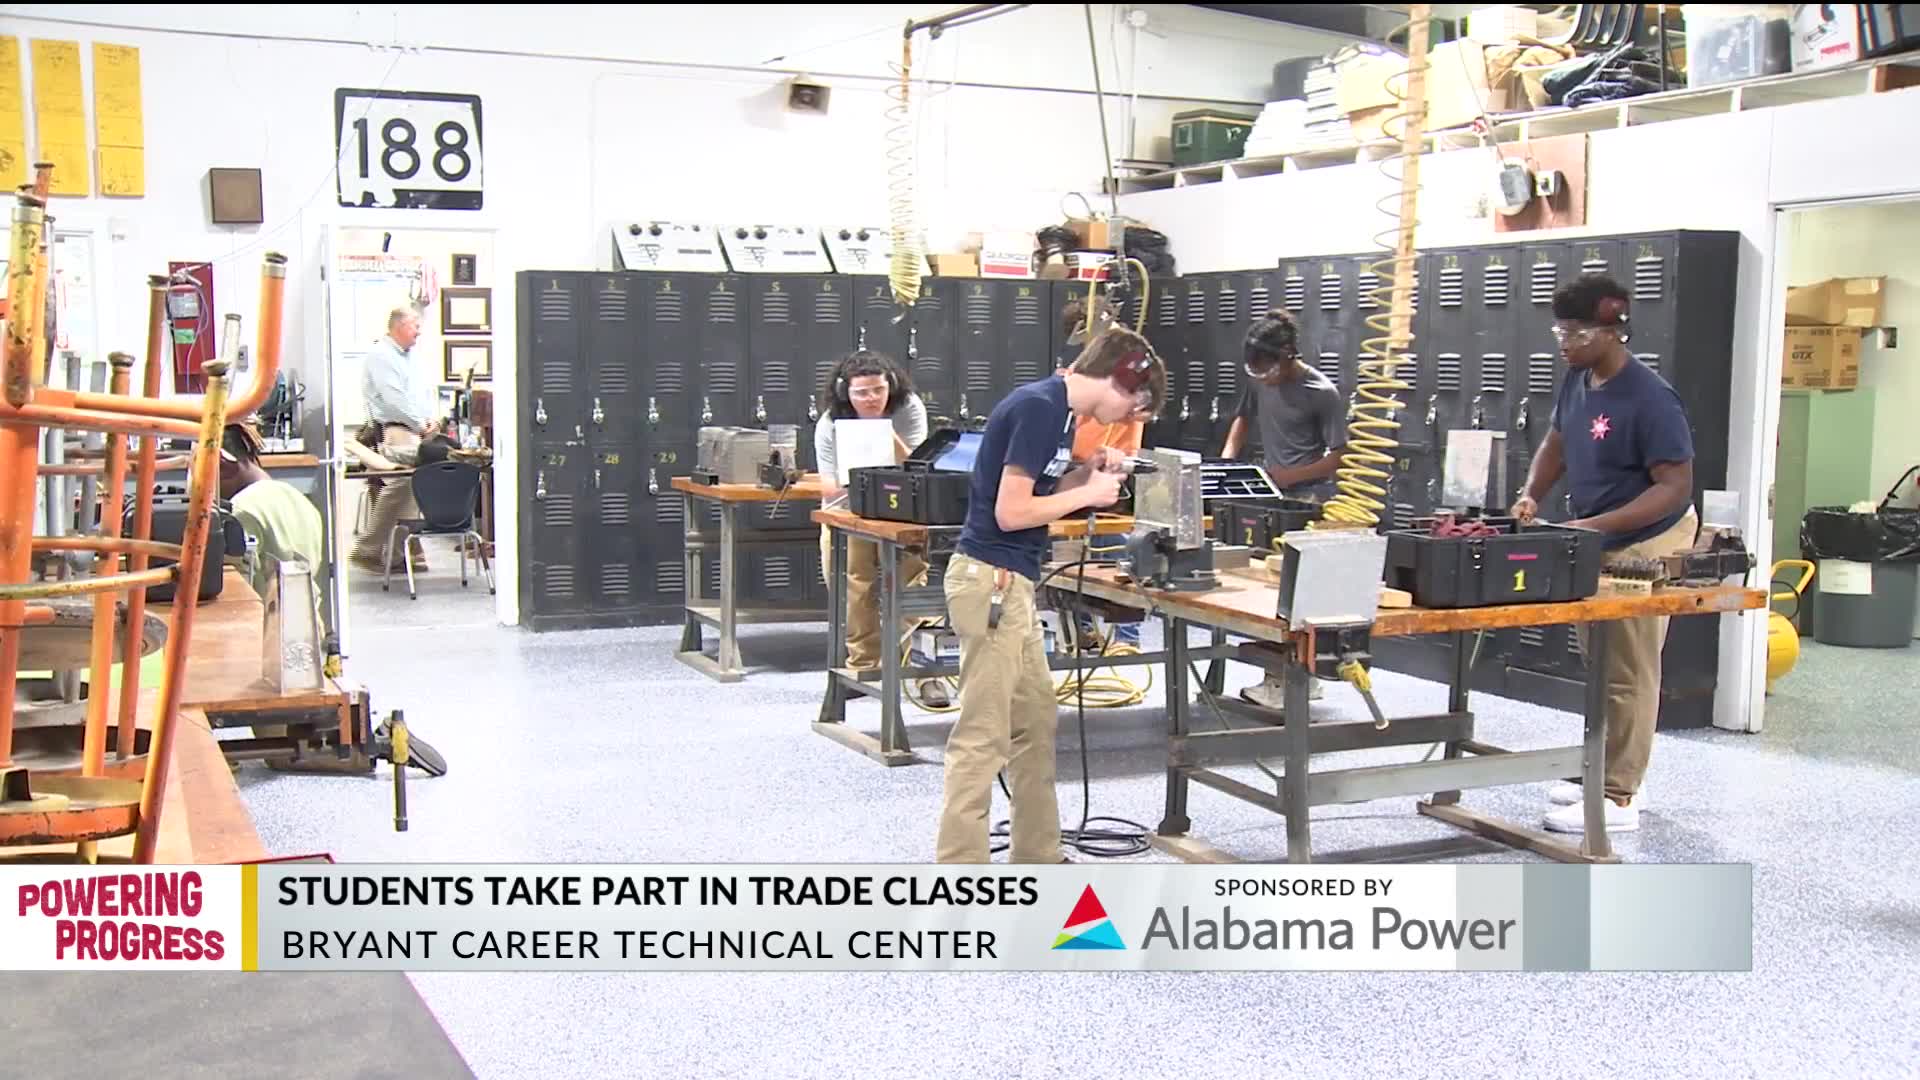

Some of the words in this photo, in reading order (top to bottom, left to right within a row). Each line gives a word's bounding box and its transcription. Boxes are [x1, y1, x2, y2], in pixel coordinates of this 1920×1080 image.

[353, 118, 471, 182] 188
[551, 279, 559, 290] 1
[607, 279, 616, 290] 2
[662, 280, 672, 291] 3
[716, 281, 725, 292] 4
[771, 281, 781, 292] 5
[823, 281, 832, 291] 6
[973, 285, 983, 295] 9
[875, 286, 883, 297] 7
[1791, 351, 1814, 360] GTX
[549, 454, 566, 466] 27
[604, 453, 620, 464] 28
[658, 452, 677, 463] 29
[889, 493, 899, 509] 5
[1244, 527, 1254, 545] 2
[1512, 568, 1528, 592] 1
